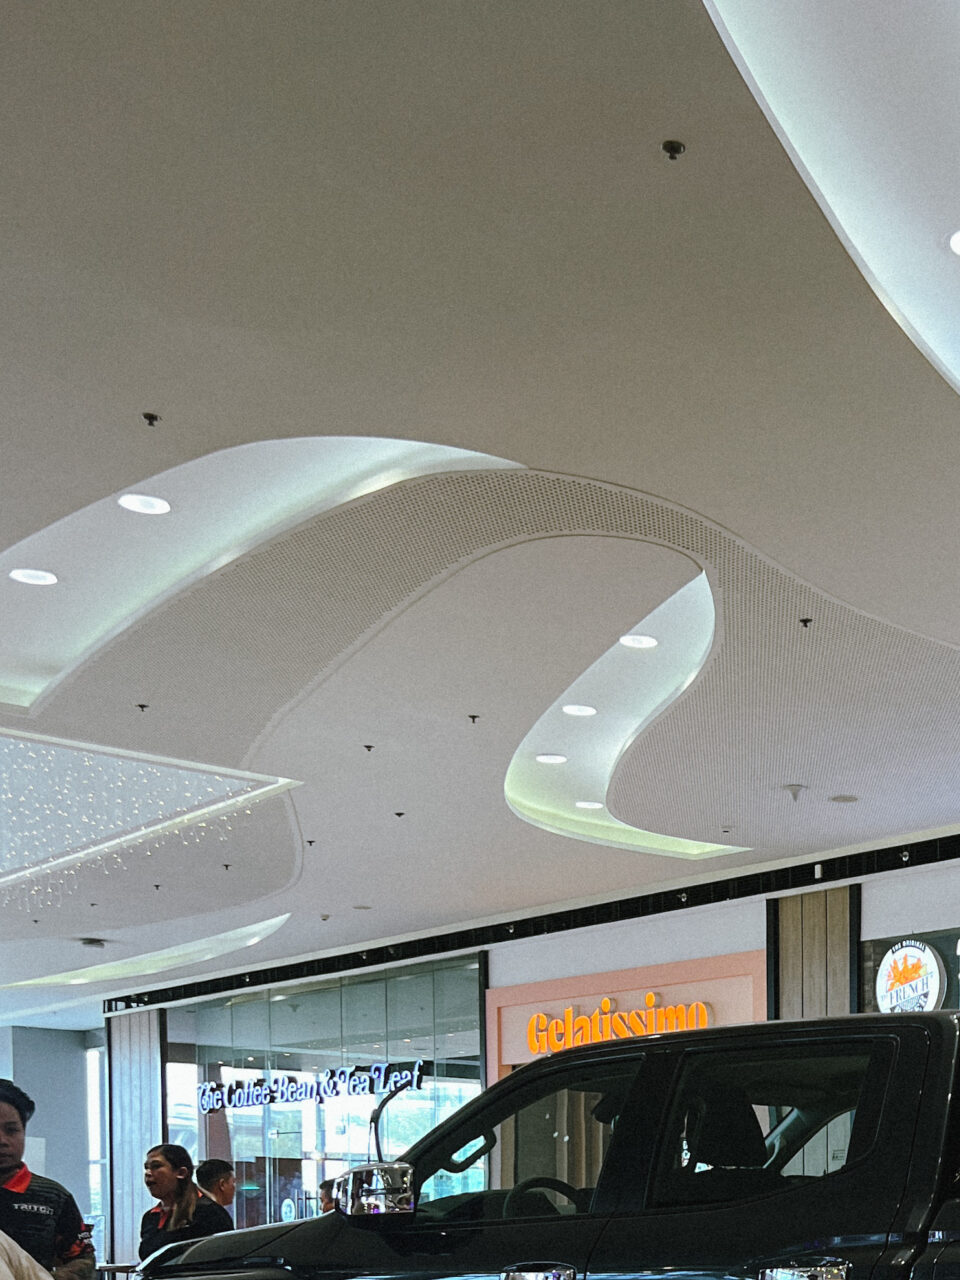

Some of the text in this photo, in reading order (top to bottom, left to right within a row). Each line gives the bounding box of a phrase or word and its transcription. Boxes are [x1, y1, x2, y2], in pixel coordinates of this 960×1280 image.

[527, 991, 708, 1055] Gelatissimo
[197, 1059, 423, 1115] The Coffee Bean & Tea Leaf
